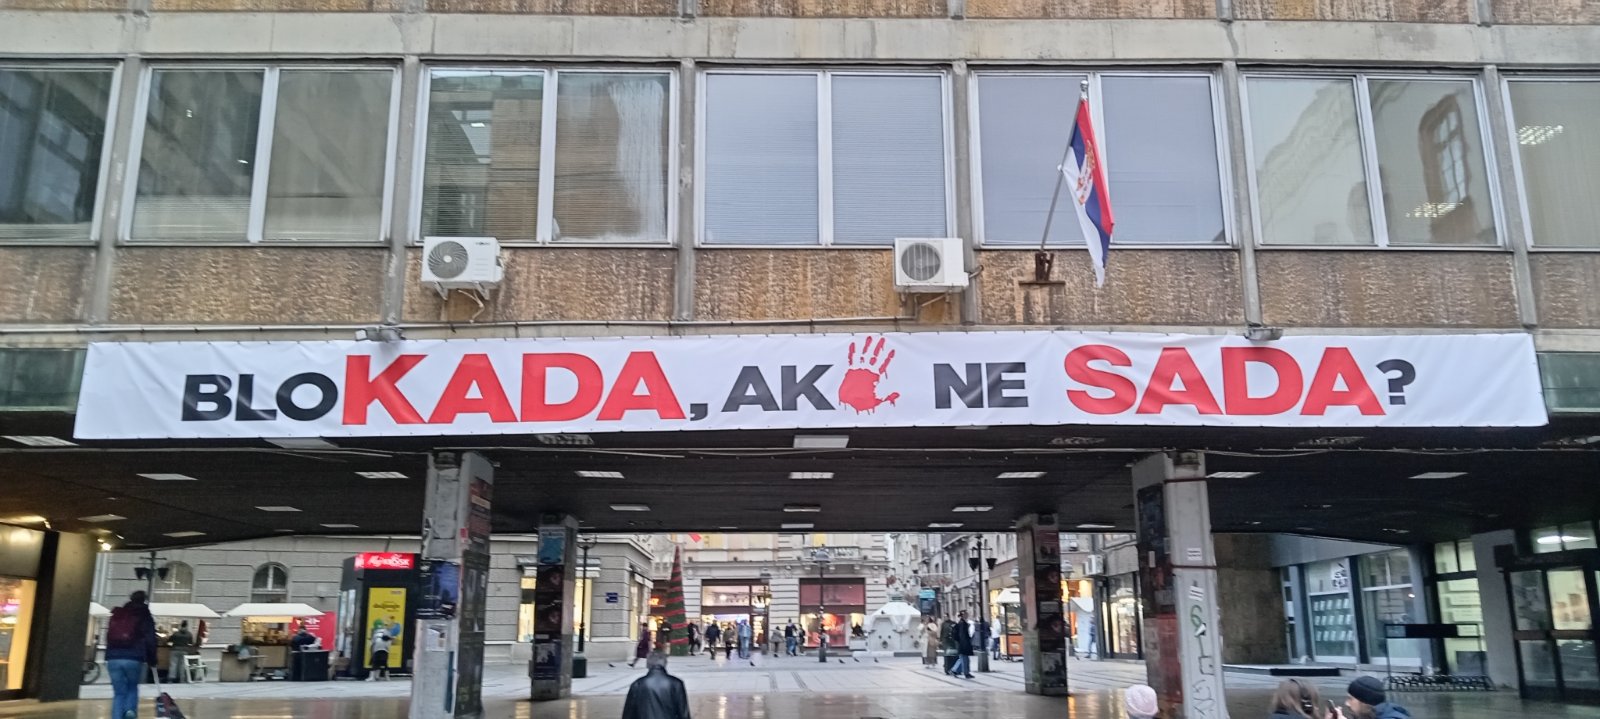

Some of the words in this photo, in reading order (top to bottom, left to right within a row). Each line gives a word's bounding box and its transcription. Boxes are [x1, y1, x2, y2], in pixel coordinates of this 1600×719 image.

[181, 351, 707, 426] BLOKADA,
[934, 361, 1028, 409] NE
[1064, 344, 1416, 417] SADA?
